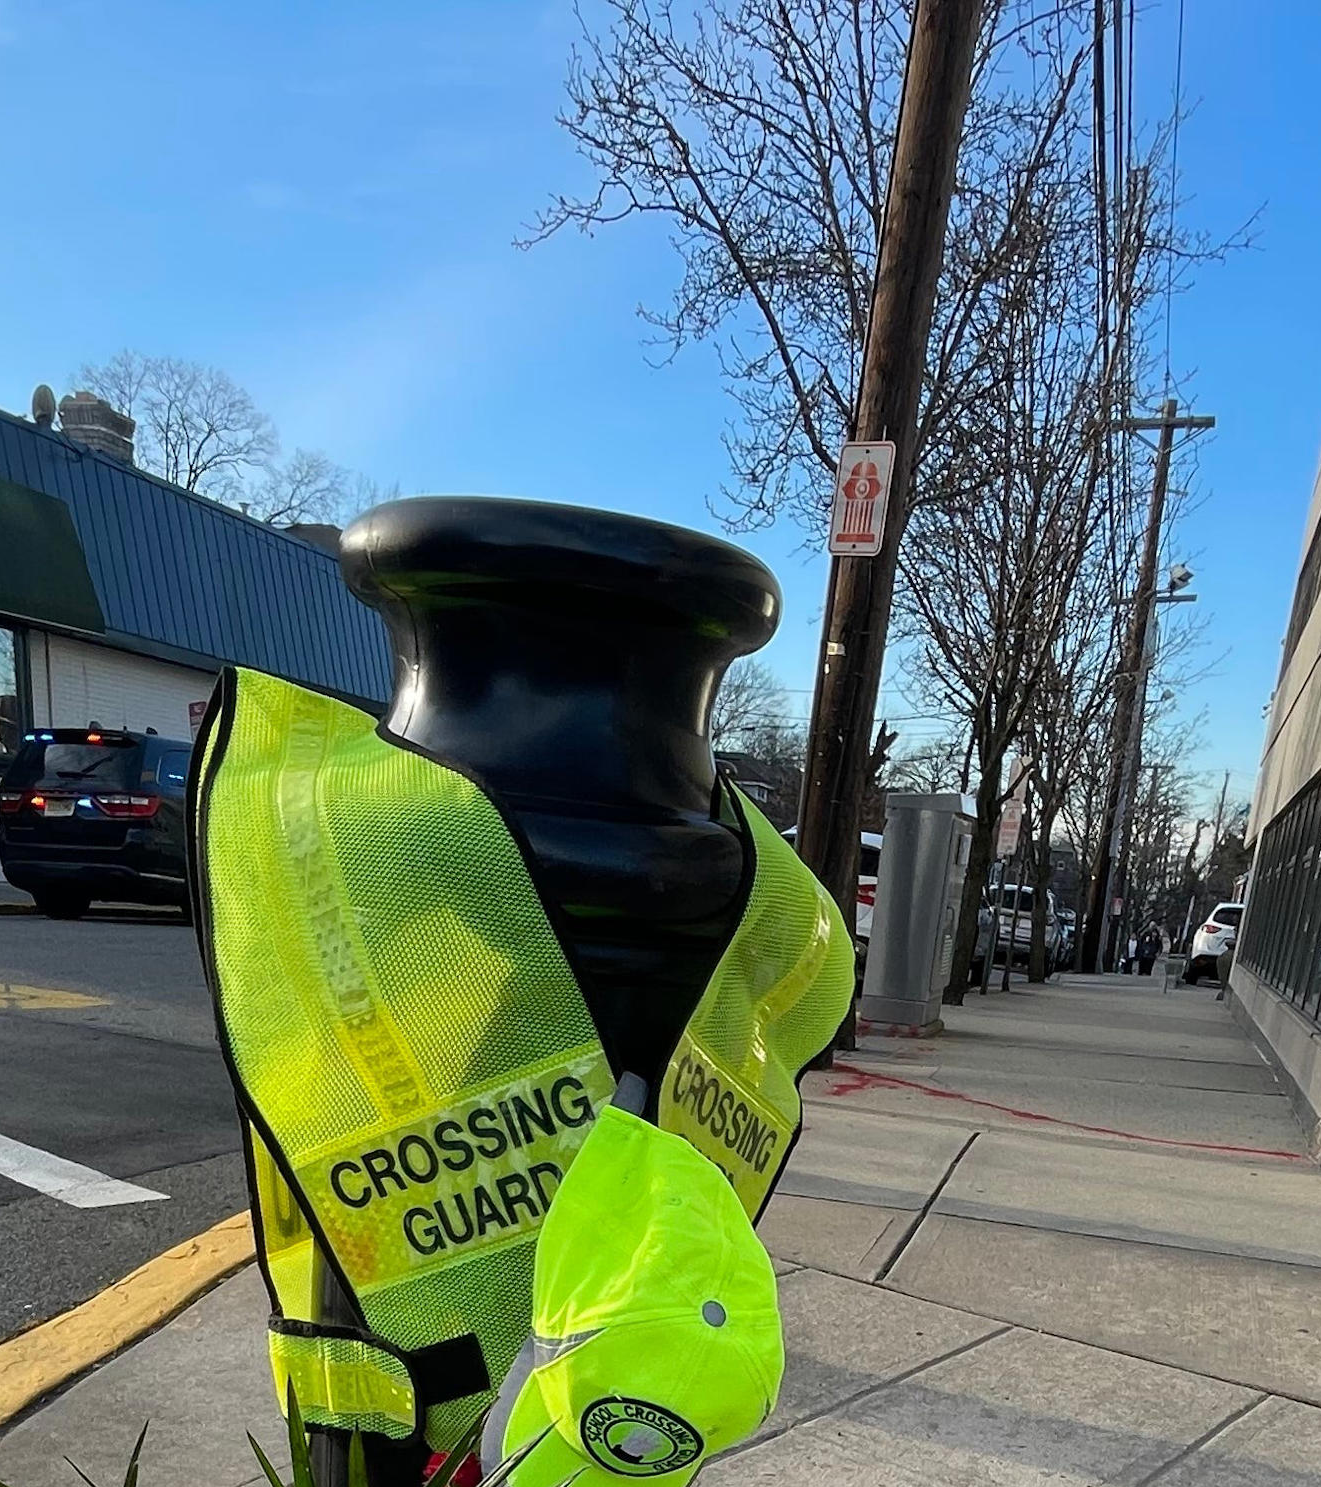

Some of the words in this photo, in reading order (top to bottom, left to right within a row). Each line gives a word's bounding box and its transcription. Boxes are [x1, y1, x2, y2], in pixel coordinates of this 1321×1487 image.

[331, 1076, 596, 1209] CROSSING
[673, 1055, 778, 1175] CROSSING
[403, 1161, 565, 1256] GUARD
[587, 1406, 620, 1444] SCHOOL
[623, 1404, 695, 1445] CROSSING
